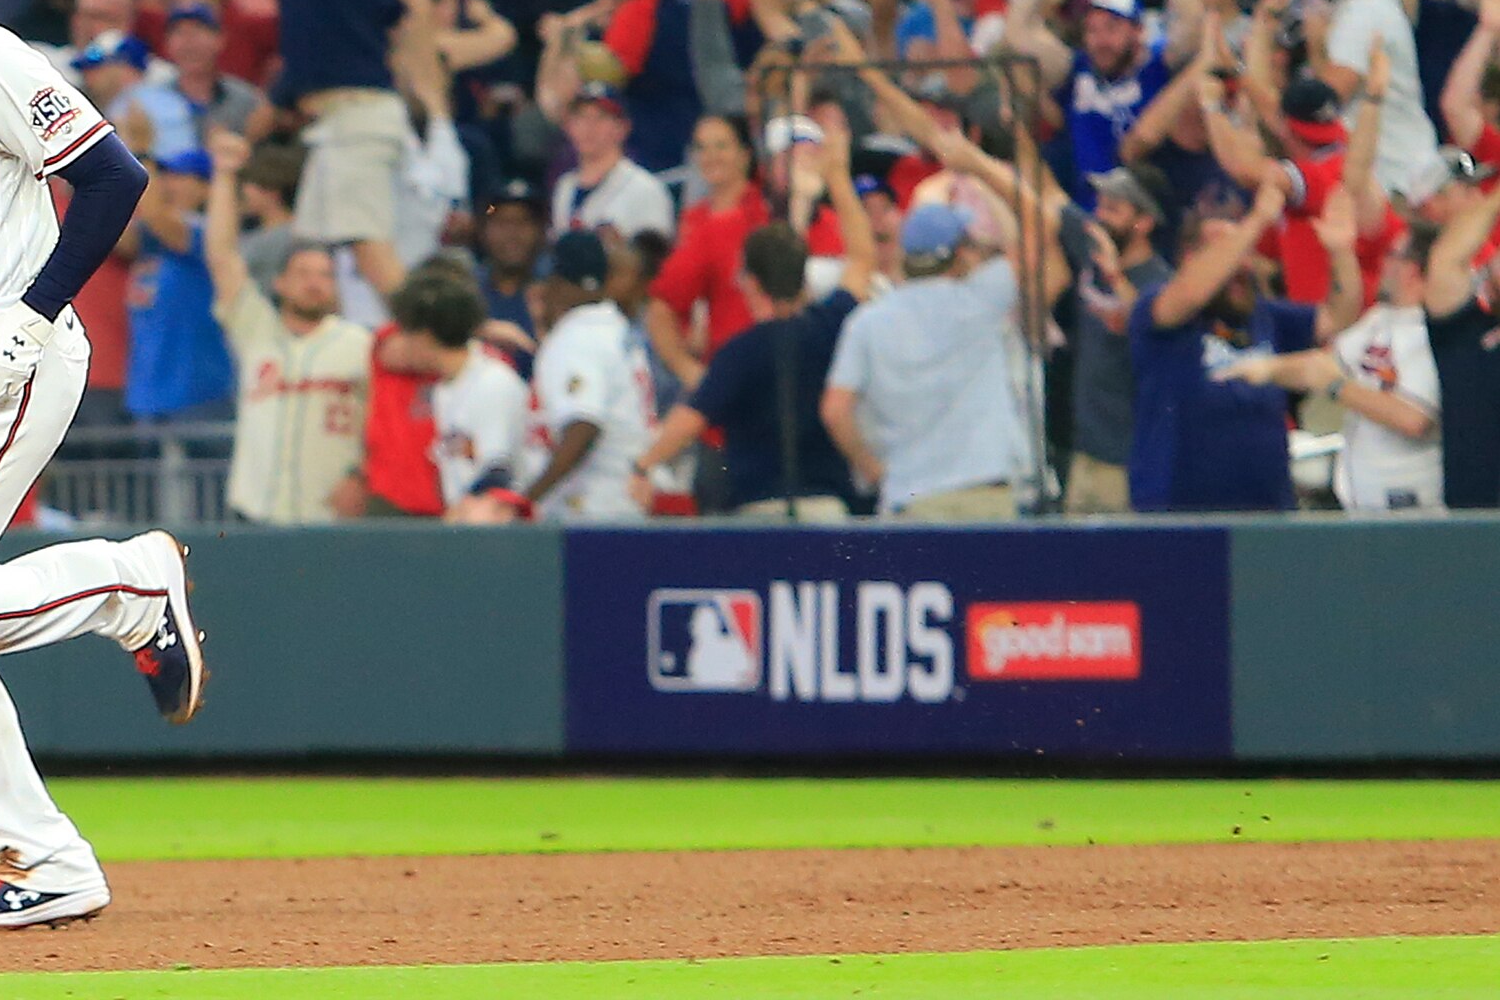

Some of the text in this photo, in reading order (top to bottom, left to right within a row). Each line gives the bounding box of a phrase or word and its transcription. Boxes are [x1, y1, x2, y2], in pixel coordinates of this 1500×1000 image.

[30, 90, 71, 131] 150
[768, 579, 954, 704] NLDS
[982, 611, 1066, 675] good
